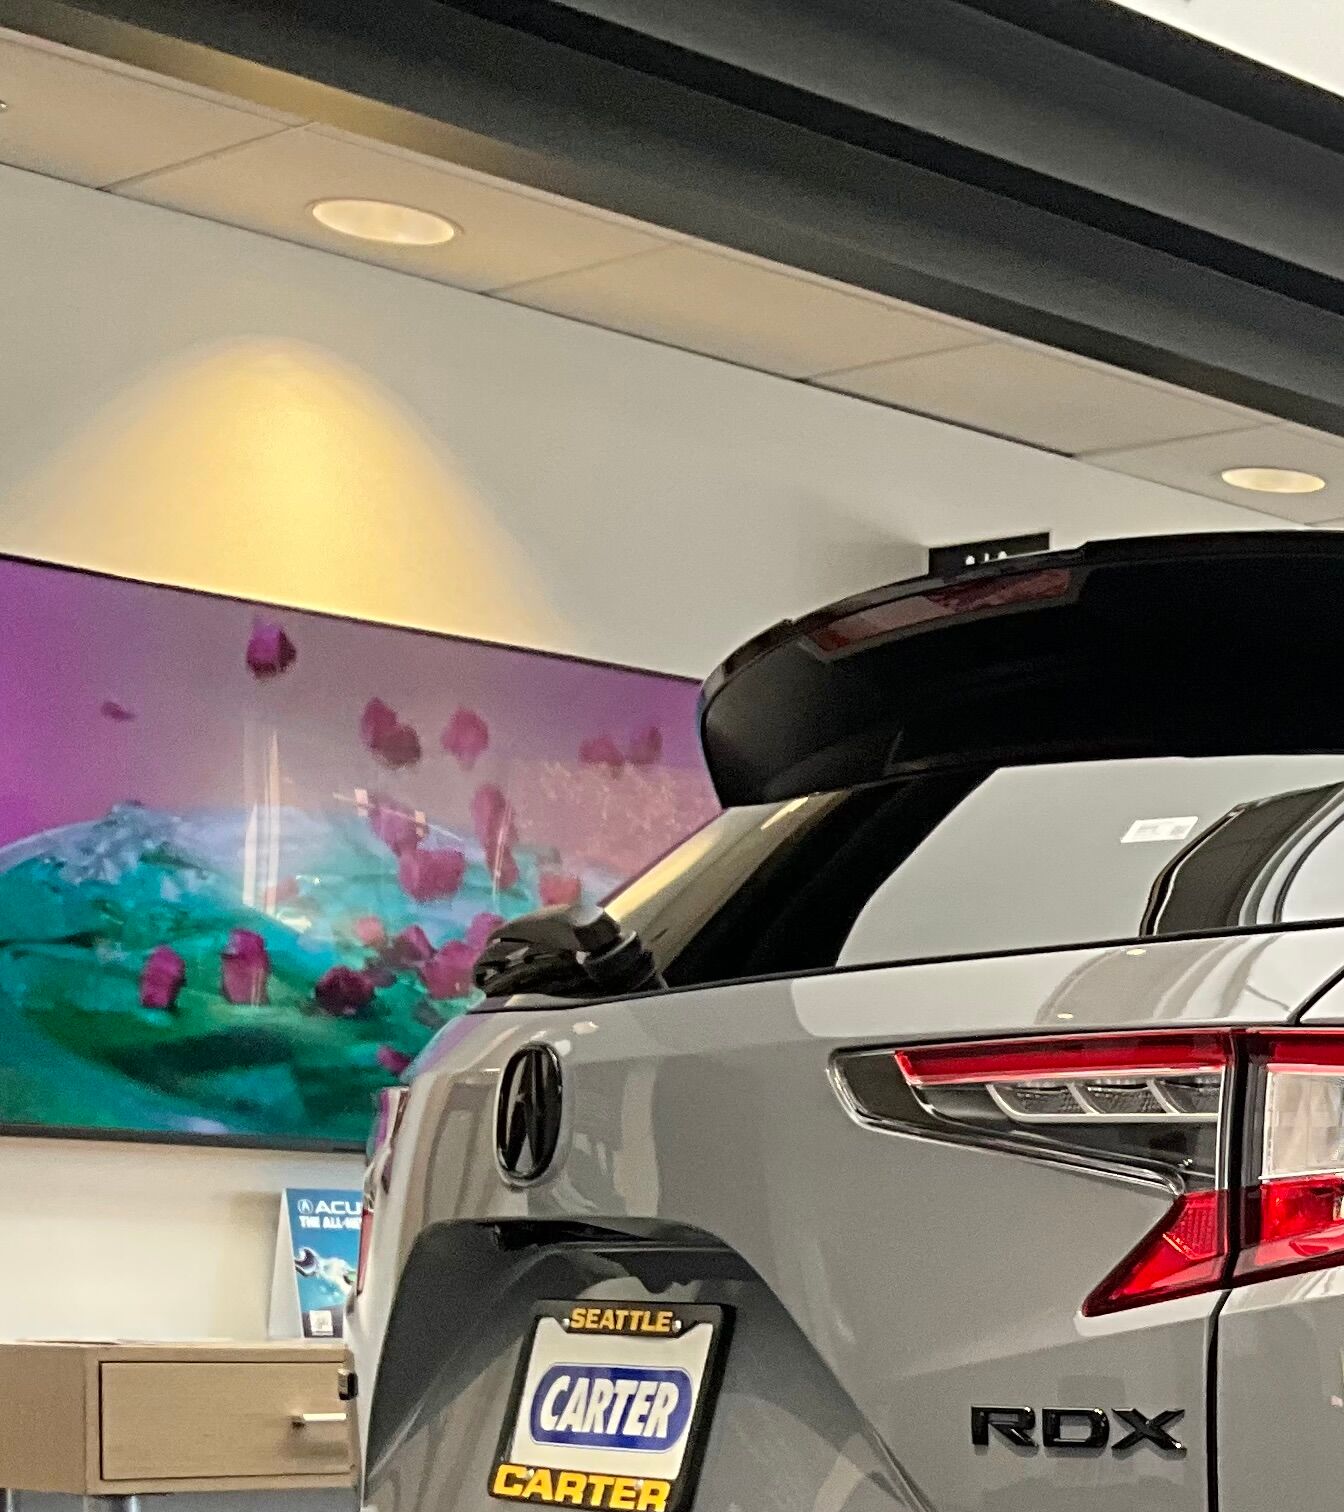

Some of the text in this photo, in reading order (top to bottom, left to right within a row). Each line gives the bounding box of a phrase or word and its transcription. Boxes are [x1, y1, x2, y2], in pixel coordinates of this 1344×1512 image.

[315, 1200, 362, 1215] ACU
[569, 1306, 674, 1333] SEATTLE
[540, 1375, 680, 1440] CARTER
[970, 1405, 1187, 1452] RDX
